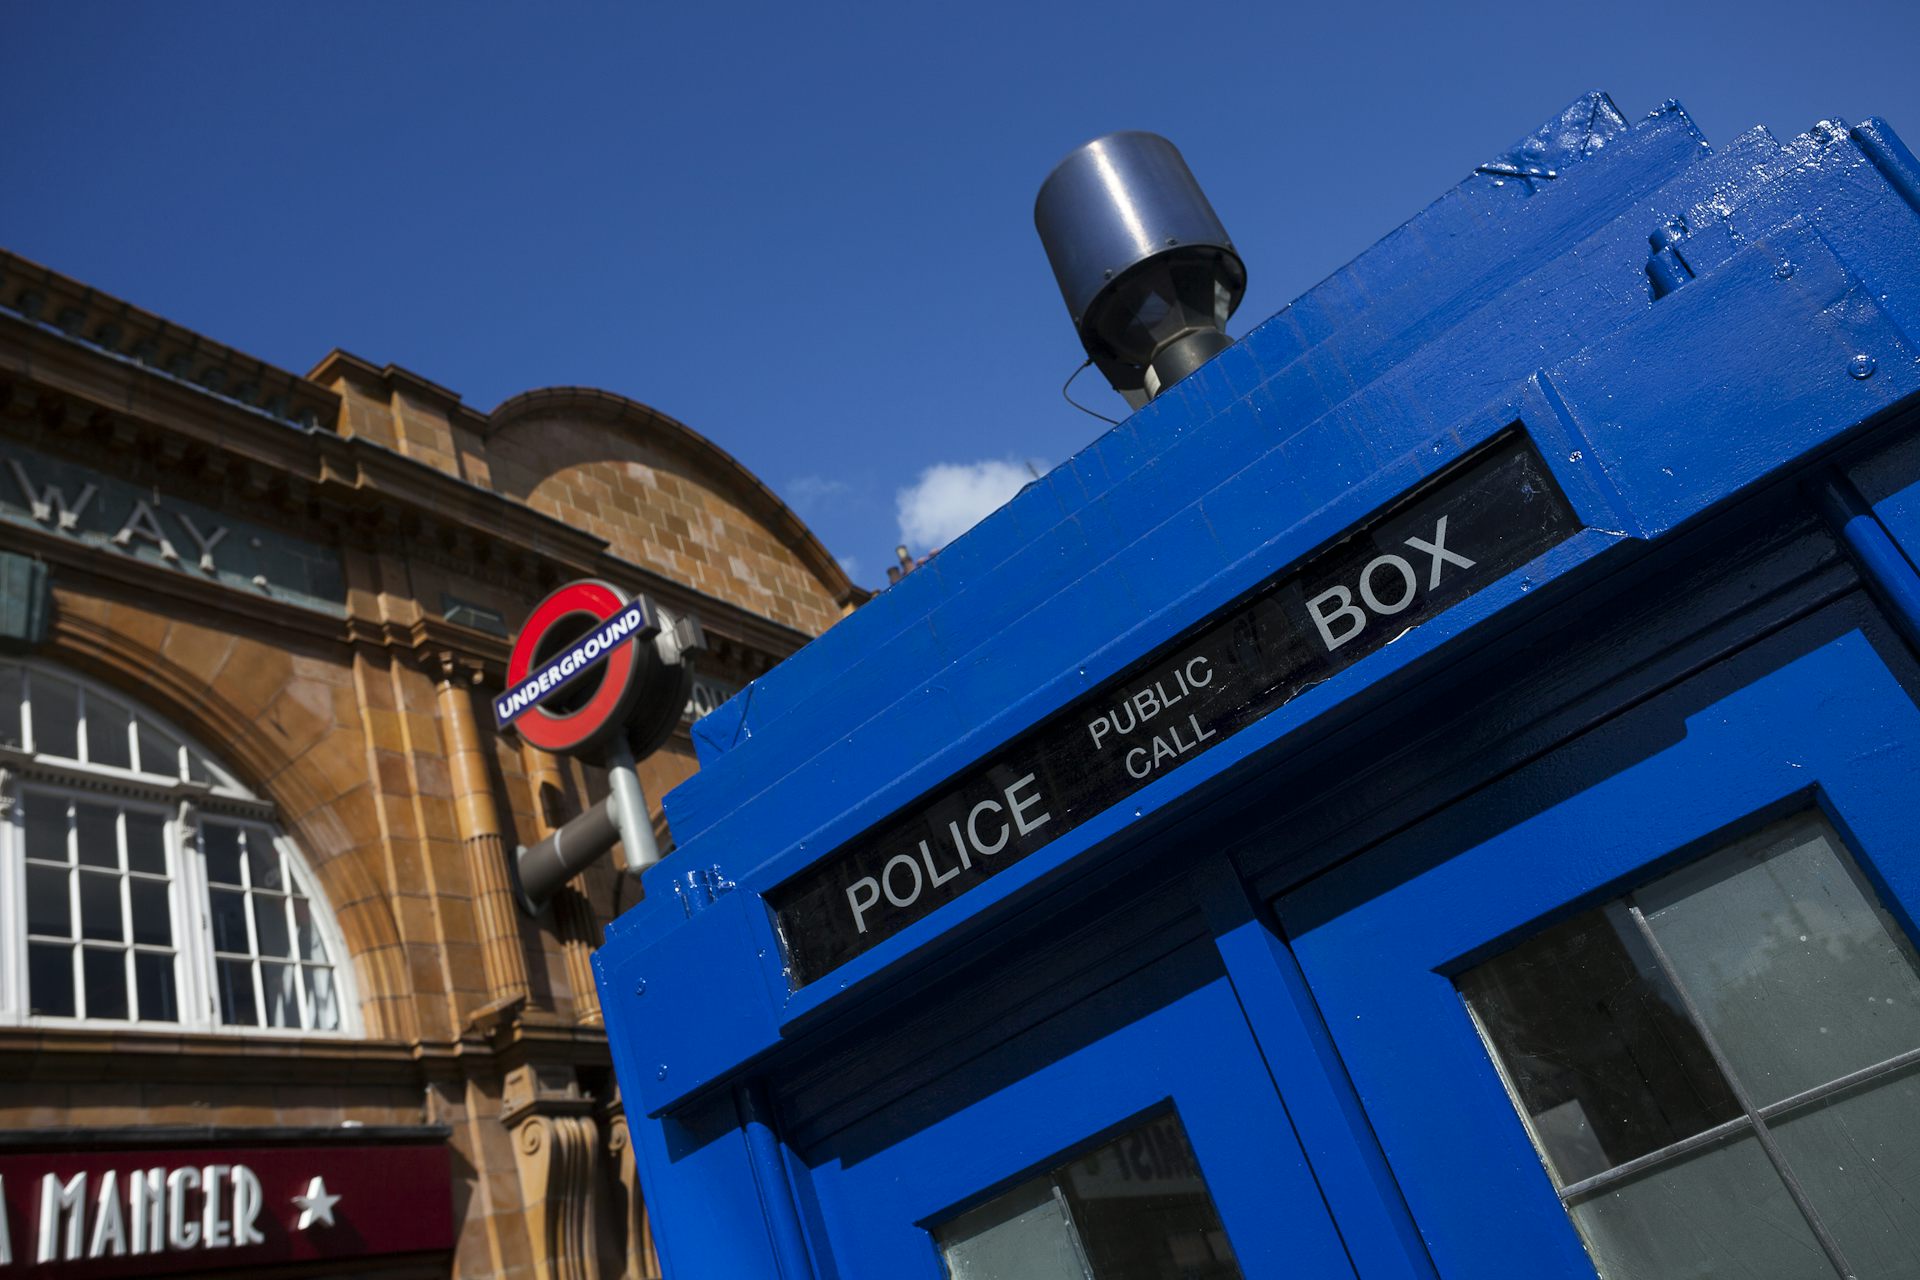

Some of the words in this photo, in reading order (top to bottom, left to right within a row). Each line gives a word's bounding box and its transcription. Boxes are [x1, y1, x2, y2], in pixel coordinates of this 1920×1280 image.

[1305, 515, 1476, 651] BOX
[498, 609, 641, 719] UNDERGROUND
[1088, 656, 1213, 749] PUBLIC
[1125, 714, 1216, 779] CALL
[845, 773, 1051, 934] POLICE
[37, 1164, 264, 1264] MANGER
